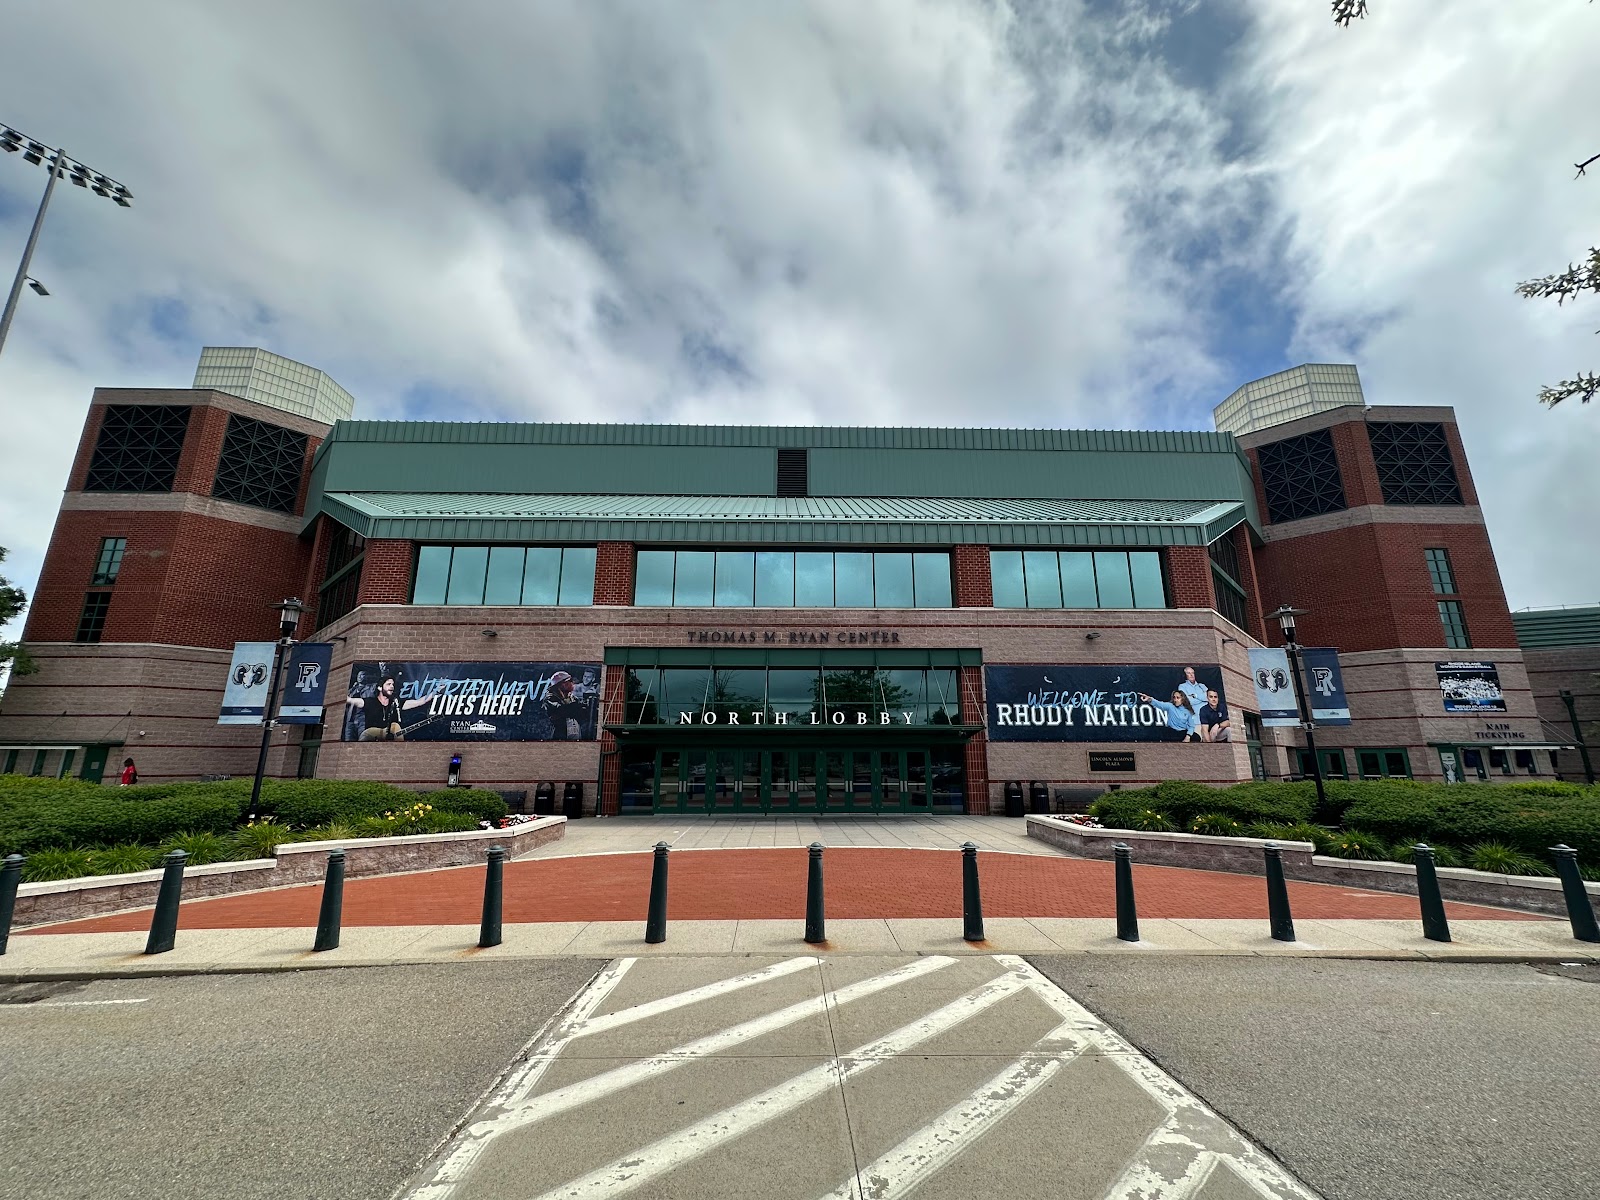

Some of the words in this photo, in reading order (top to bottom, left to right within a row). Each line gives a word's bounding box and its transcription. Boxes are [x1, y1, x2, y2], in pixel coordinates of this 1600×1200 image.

[688, 631, 756, 643] THOMAS
[764, 631, 781, 643] M.
[789, 631, 830, 643] RYAN
[837, 631, 901, 643] CENTER
[400, 673, 551, 701] ENTERTAINMENT
[428, 695, 477, 716] LIVES
[478, 695, 526, 716] HERE!
[1027, 688, 1107, 708] WELCOME
[1115, 691, 1138, 708] TO
[680, 711, 788, 725] NORTH
[811, 711, 913, 725] LOBBY
[996, 704, 1074, 726] RHODY
[1084, 704, 1169, 727] NATION
